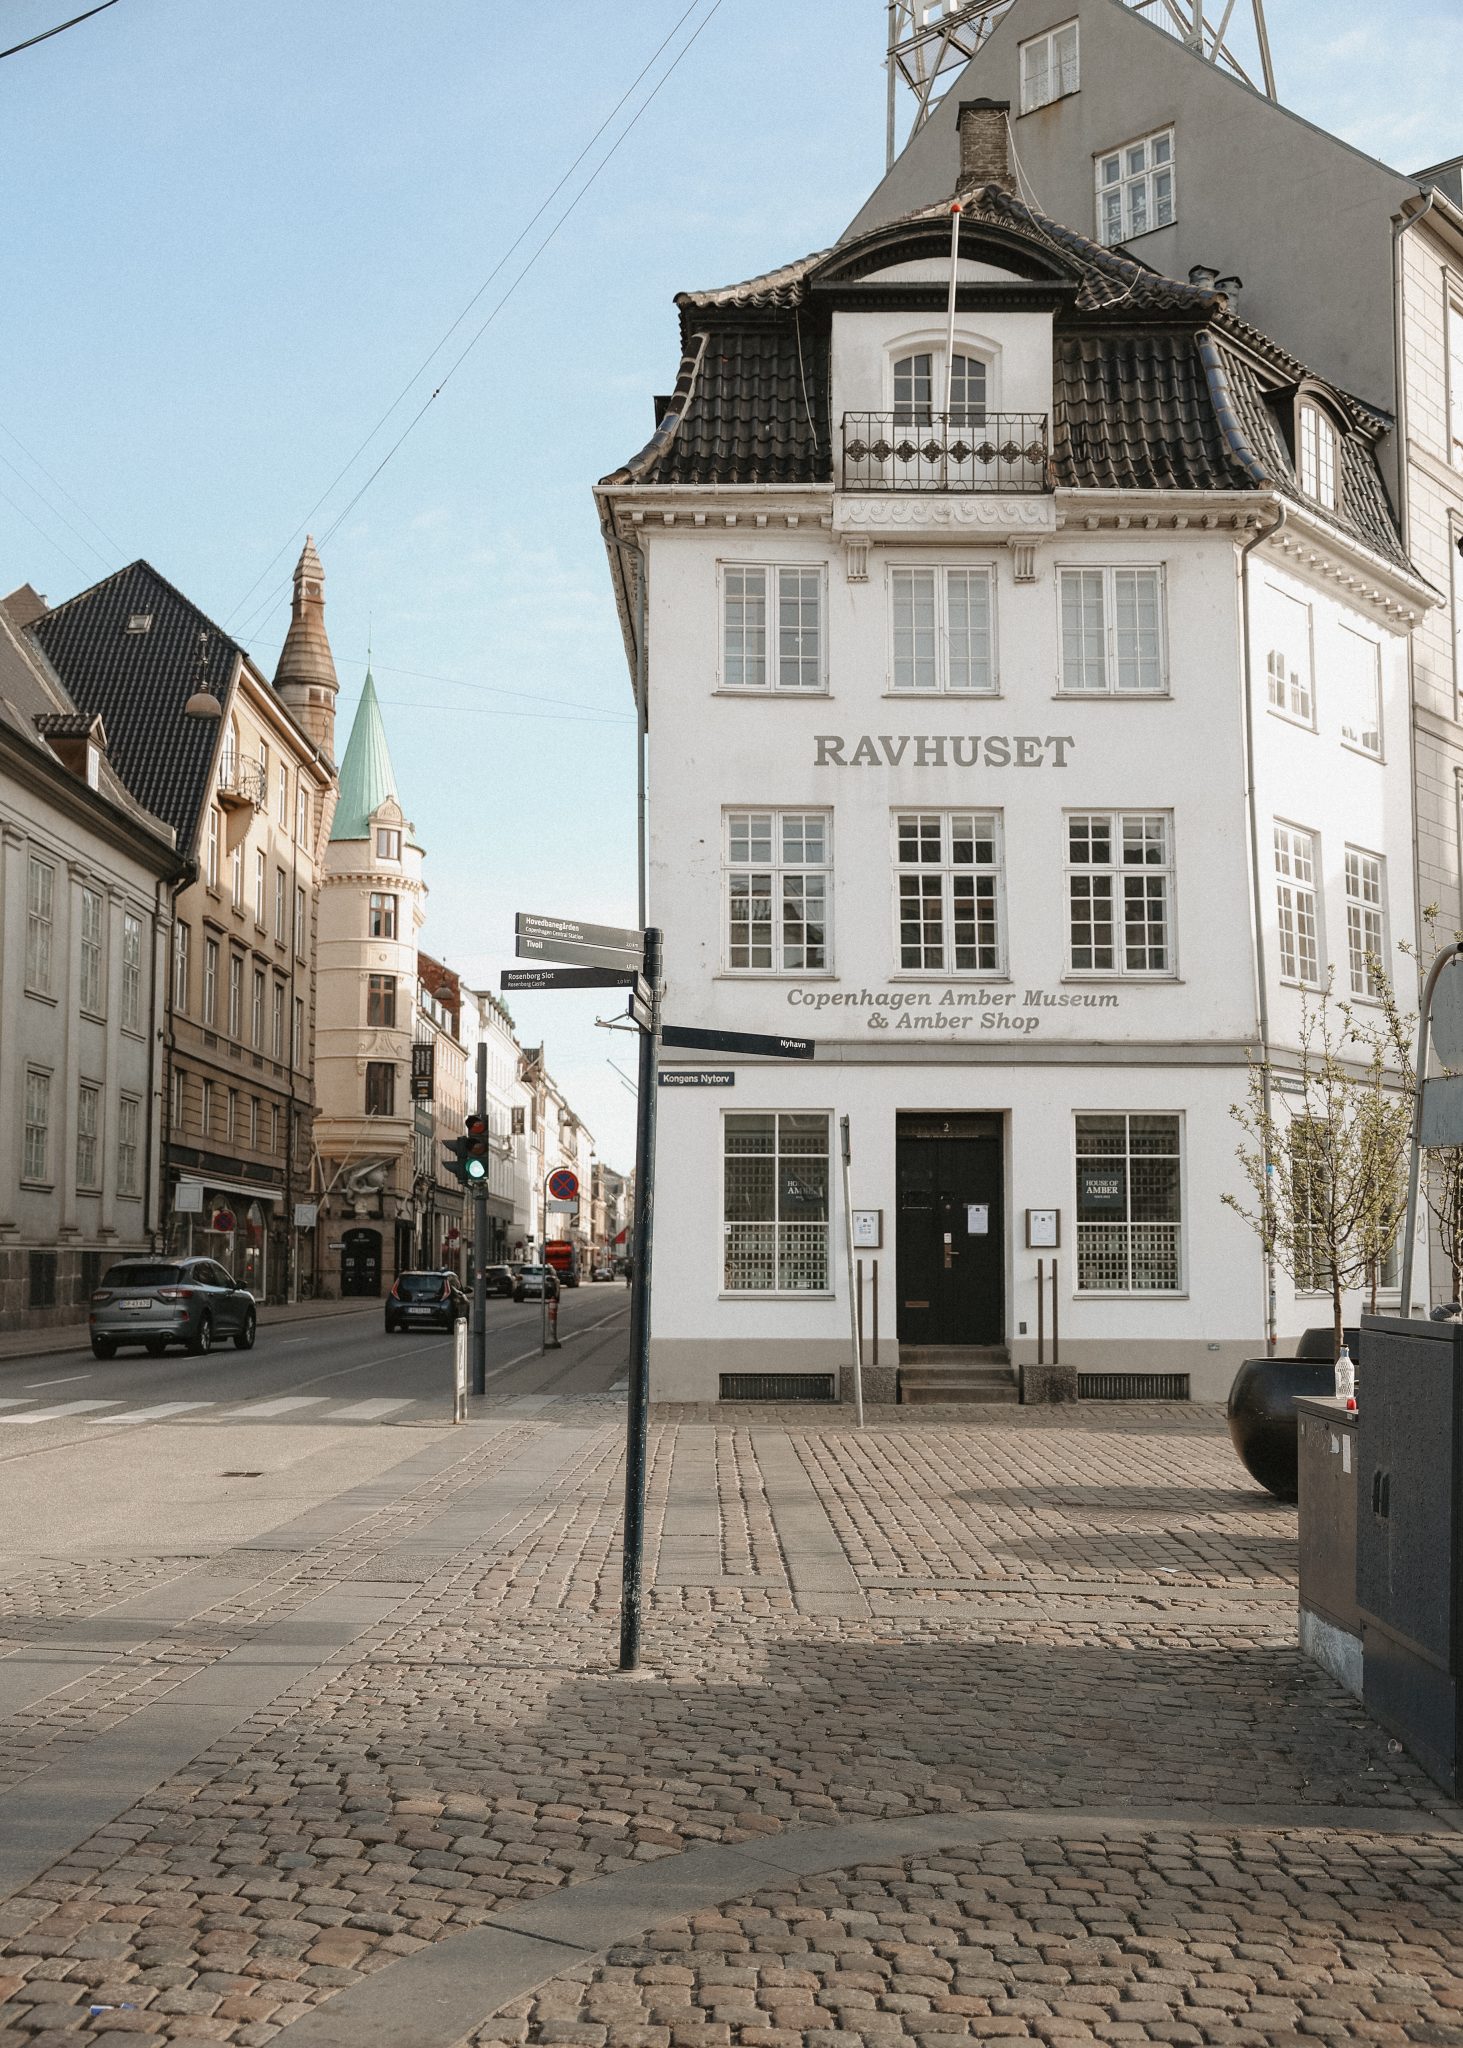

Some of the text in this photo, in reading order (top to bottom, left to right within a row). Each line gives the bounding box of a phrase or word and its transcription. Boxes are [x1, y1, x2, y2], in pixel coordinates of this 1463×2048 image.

[813, 735, 1076, 768] RAVHUSET
[525, 917, 580, 932] Hovedbanegården
[525, 926, 584, 940] Copenhagen Central Station
[526, 940, 543, 949] Tivoli
[508, 971, 555, 981] Rosenborg Slot
[787, 988, 1120, 1010] Copenhagen Amber Museum
[867, 1012, 1040, 1034] & Amber Shop
[780, 1039, 807, 1049] Nyhavn
[663, 1074, 730, 1084] Kongens Nytorv
[943, 1122, 950, 1132] 2
[1086, 1186, 1119, 1194] AMBER
